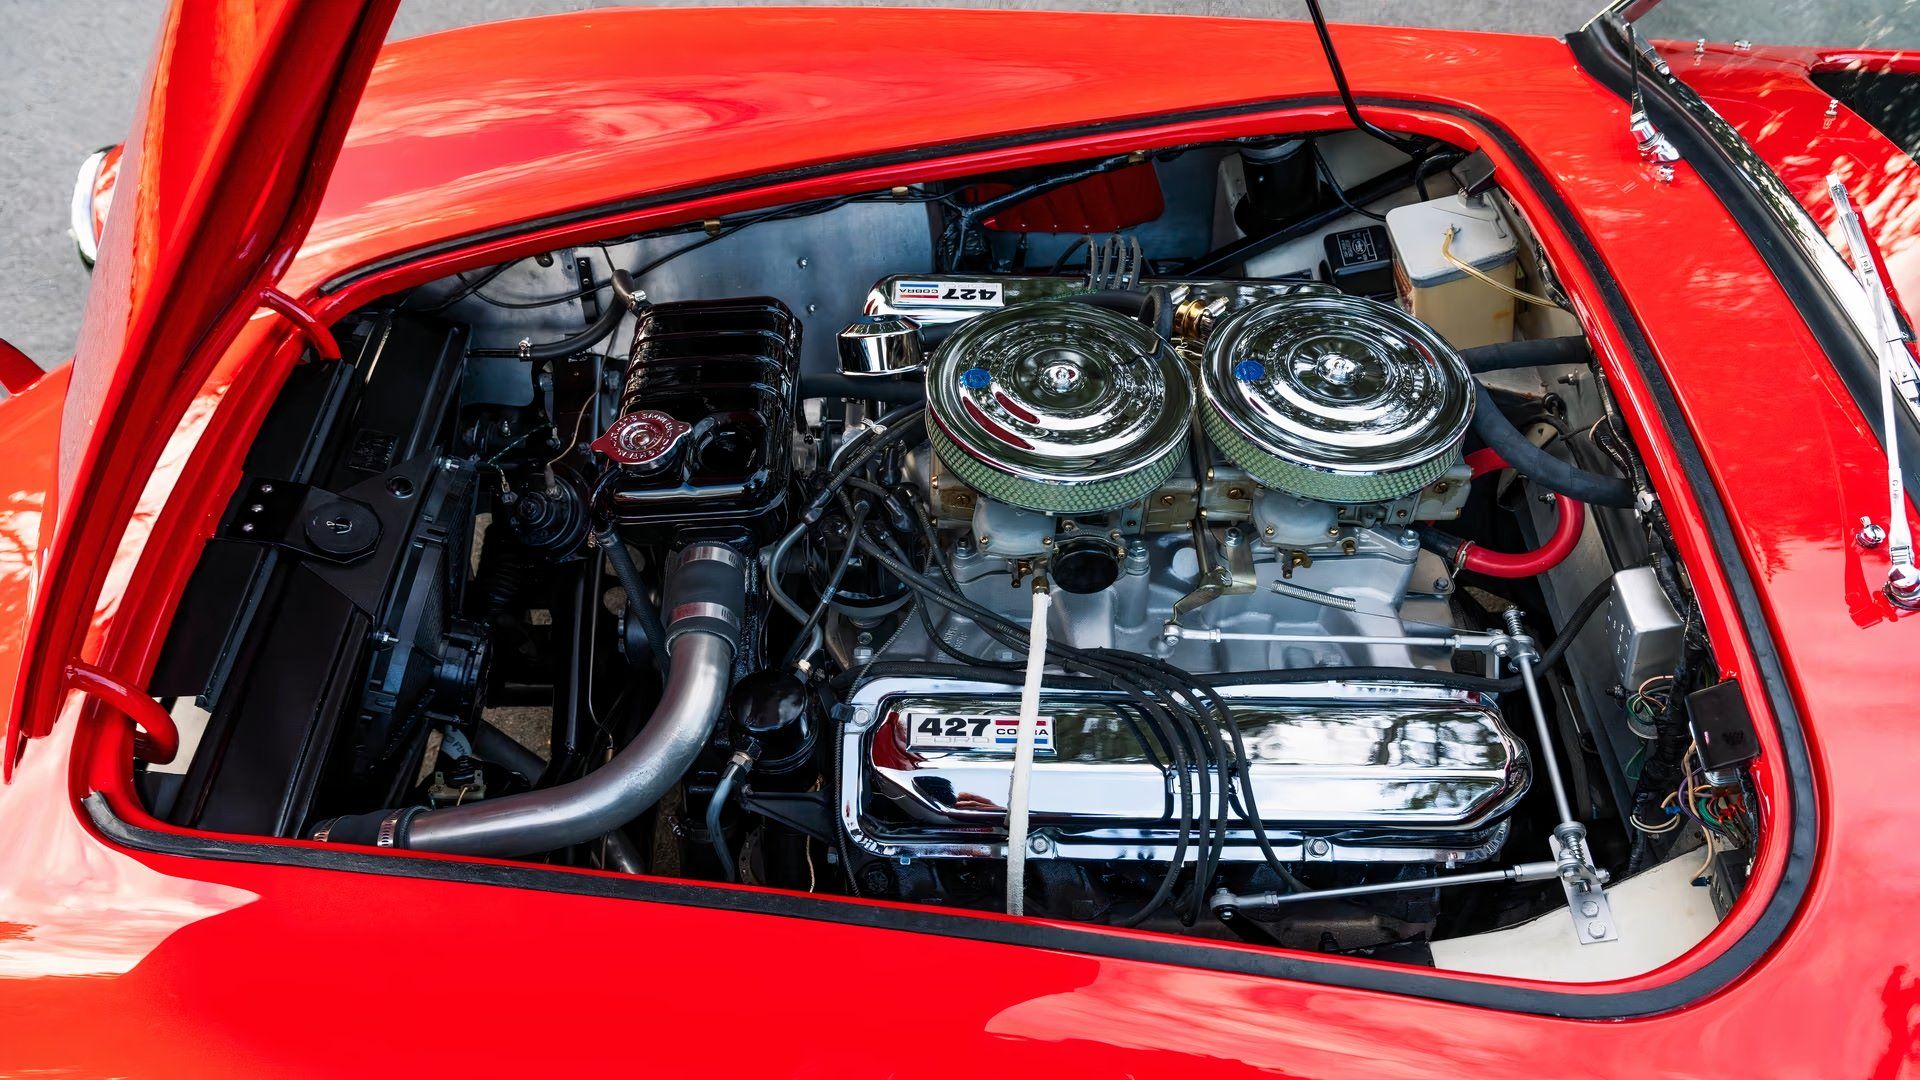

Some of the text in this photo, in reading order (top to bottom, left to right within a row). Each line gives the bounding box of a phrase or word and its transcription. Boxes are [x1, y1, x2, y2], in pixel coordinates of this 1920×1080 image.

[942, 288, 997, 301] 427
[917, 718, 1049, 736] 427 COA
[915, 736, 990, 744] FORD
